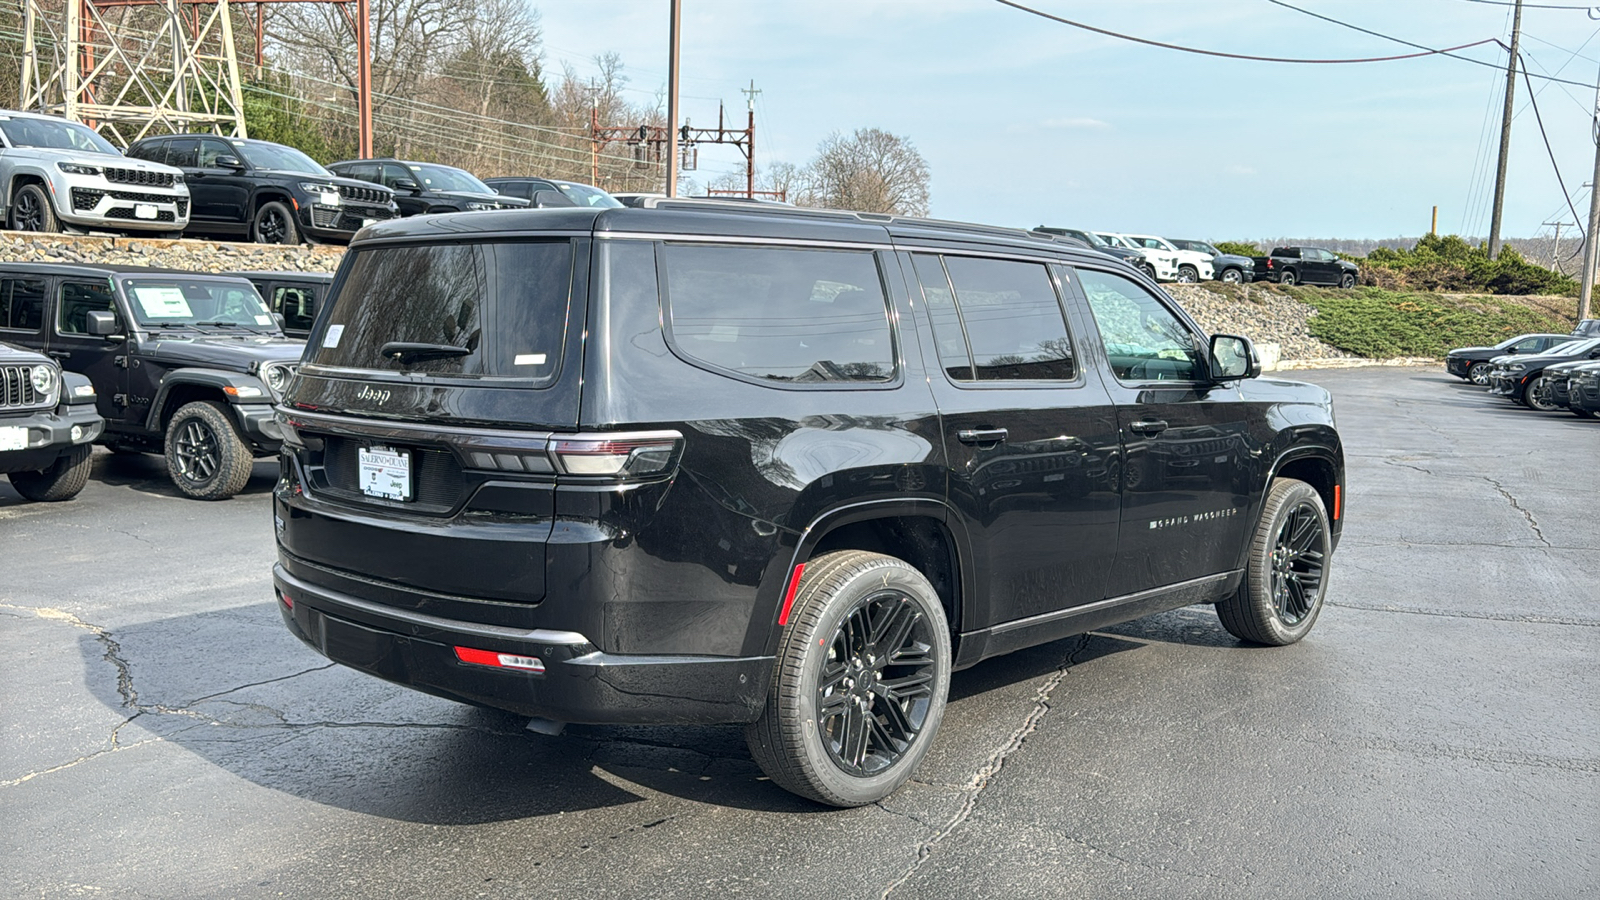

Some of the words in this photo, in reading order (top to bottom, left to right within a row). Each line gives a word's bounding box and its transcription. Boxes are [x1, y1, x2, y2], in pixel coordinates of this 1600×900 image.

[357, 385, 390, 406] Jeep
[389, 457, 408, 468] DUANE
[390, 480, 403, 489] Jeep
[1158, 516, 1188, 528] GRAND
